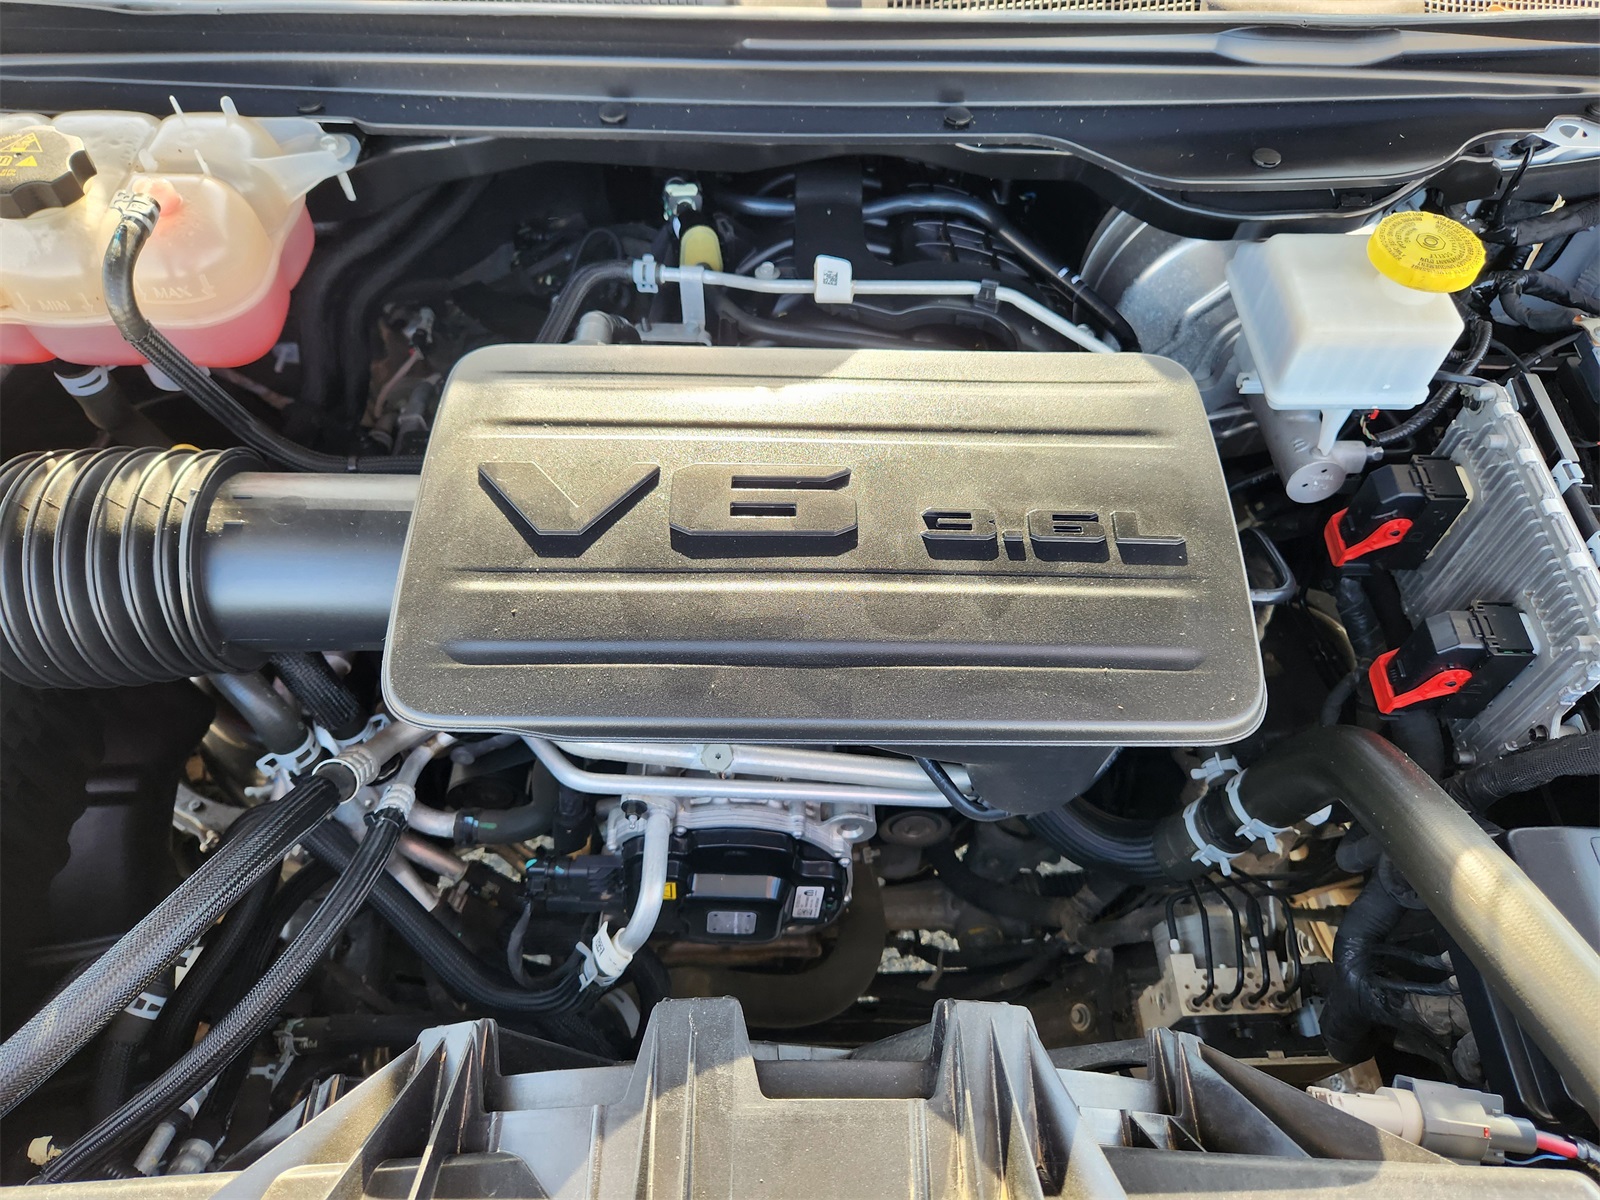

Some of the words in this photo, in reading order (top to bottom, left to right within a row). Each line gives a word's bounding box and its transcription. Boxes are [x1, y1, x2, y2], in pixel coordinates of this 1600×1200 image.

[153, 286, 192, 298] MAX
[38, 300, 71, 312] MIN
[478, 462, 858, 550] V6
[920, 507, 1187, 557] 3.6L
